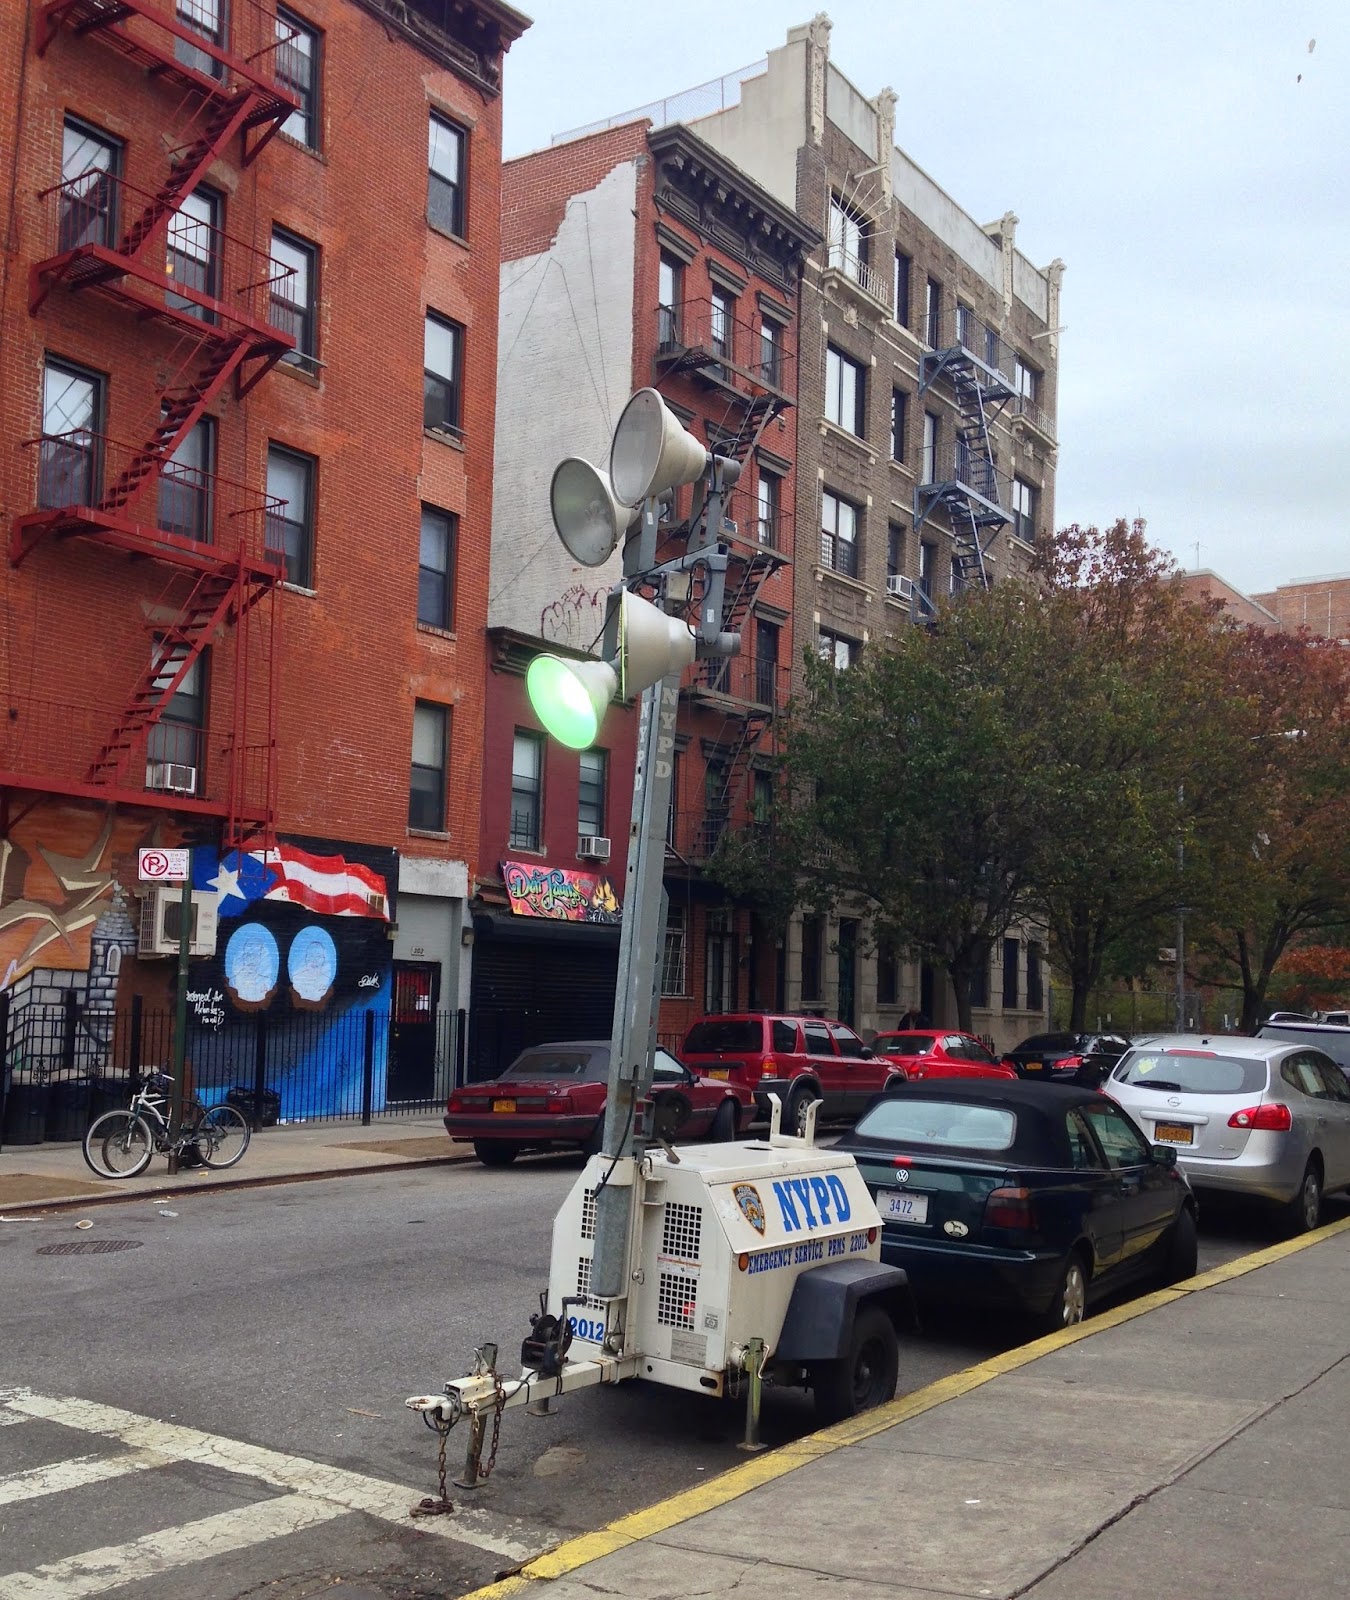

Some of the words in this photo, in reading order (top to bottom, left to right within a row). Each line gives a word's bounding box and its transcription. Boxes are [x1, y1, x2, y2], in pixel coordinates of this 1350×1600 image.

[634, 701, 650, 791] NYPD
[655, 687, 679, 778] NYPD
[772, 1174, 851, 1232] NYPD
[889, 1199, 913, 1214] 3472
[747, 1247, 793, 1275] EMERGENCY
[794, 1240, 824, 1264] SERVICE
[849, 1232, 868, 1253] 22012
[561, 1315, 605, 1342] 2012
